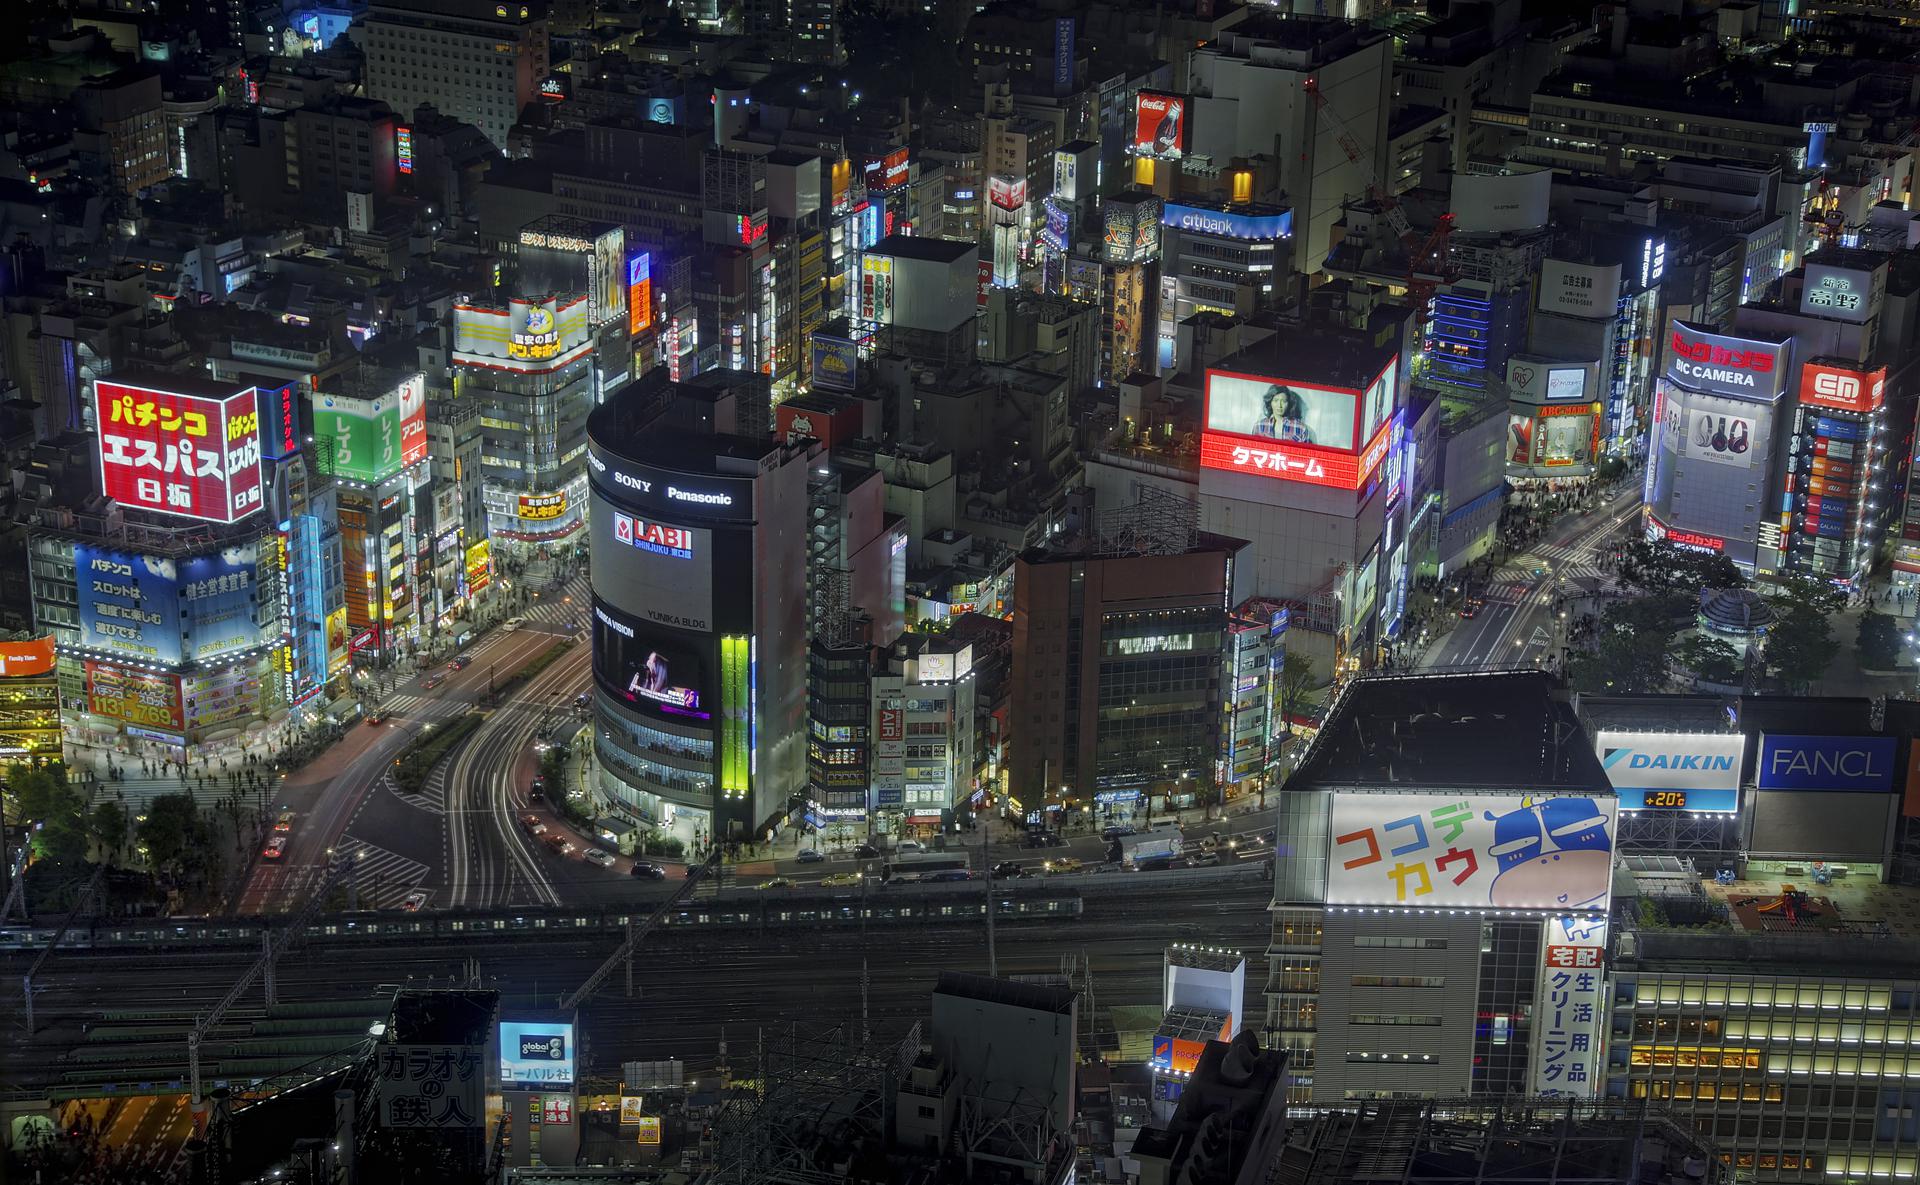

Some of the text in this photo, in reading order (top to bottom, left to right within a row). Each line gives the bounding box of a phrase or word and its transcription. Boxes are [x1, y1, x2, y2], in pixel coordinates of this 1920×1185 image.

[1807, 123, 1830, 132] AOKI
[1183, 213, 1233, 233] citibank
[1823, 277, 1848, 289] 新宿
[1809, 290, 1859, 309] 高野
[1671, 331, 1774, 373] ビックカメラ
[1676, 358, 1755, 388] BIC CAMERA
[111, 395, 208, 437] パチンコ
[228, 411, 257, 442] パチンコ
[335, 416, 352, 465] レイク
[382, 415, 393, 463] レイク
[402, 421, 424, 440] アコム
[1536, 424, 1545, 456] SALE
[104, 434, 224, 481] エスパス
[229, 437, 260, 475] エスパス
[1232, 446, 1324, 478] タマホーム
[138, 479, 192, 508] 日拓
[614, 471, 651, 493] SONY
[1827, 484, 1841, 493] au
[235, 485, 260, 510] 日拓
[667, 487, 732, 505] Panasonic
[1822, 502, 1844, 513] GALAXY
[633, 518, 692, 550] LABI
[1819, 521, 1842, 532] GALAXY
[634, 539, 668, 555] SHINJUKU
[91, 559, 132, 576] パチンコ
[186, 570, 249, 602] 健全営業宣言
[611, 618, 634, 639] VISION
[647, 610, 680, 625] YUNIKA
[139, 694, 167, 707] スロット
[1629, 754, 1734, 771] DAIKIN
[1771, 749, 1882, 778] FANCL
[1336, 800, 1475, 871] ココデ
[1387, 847, 1479, 901] カウ
[1551, 947, 1598, 967] 宅配
[1543, 971, 1572, 1083] クリーニング
[1567, 972, 1595, 1082] 生活用品
[522, 1042, 549, 1055] global
[380, 1047, 484, 1082] カラオケ
[419, 1078, 446, 1100] の
[388, 1096, 474, 1127] 鉄人
